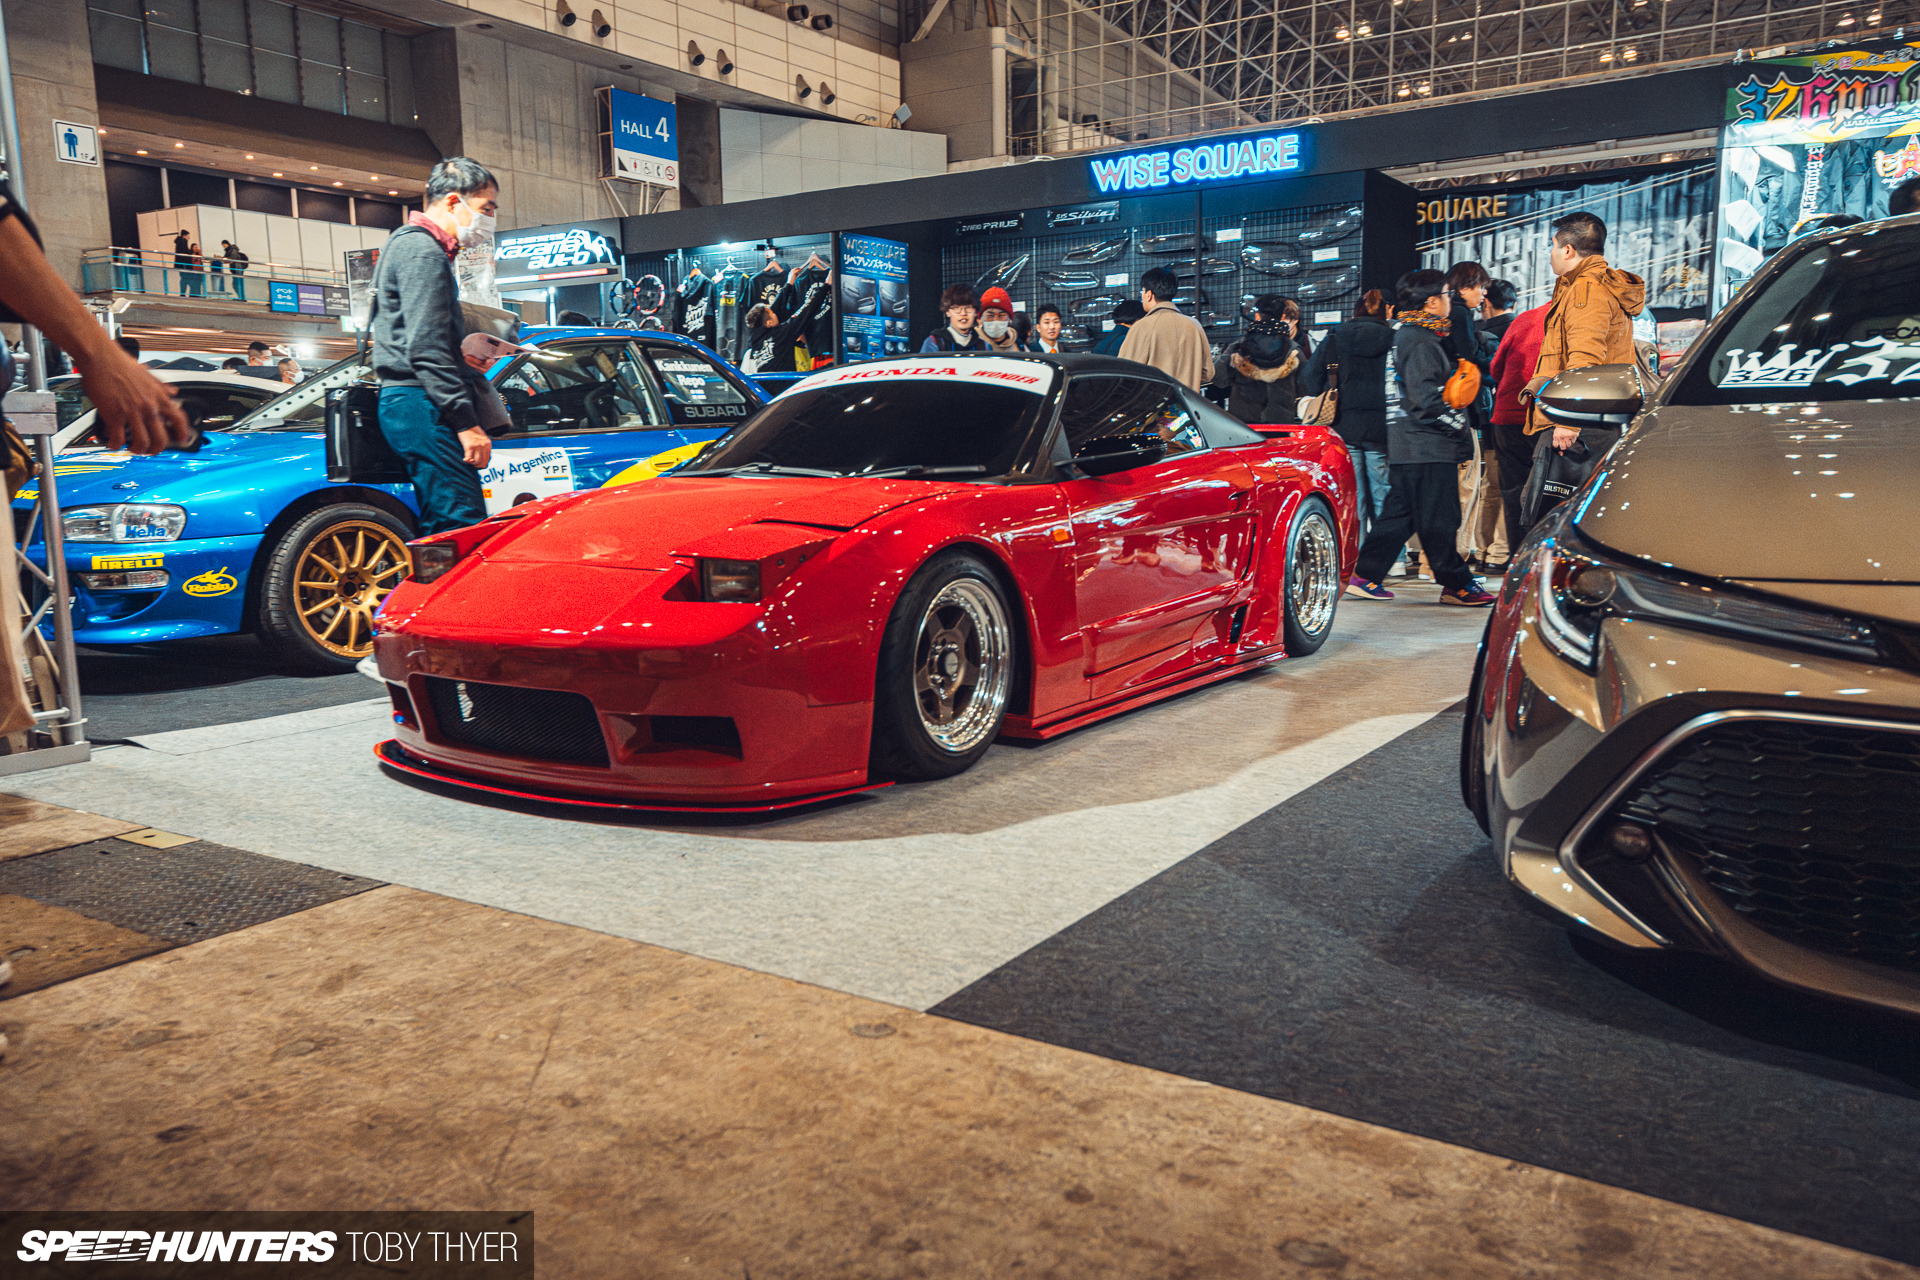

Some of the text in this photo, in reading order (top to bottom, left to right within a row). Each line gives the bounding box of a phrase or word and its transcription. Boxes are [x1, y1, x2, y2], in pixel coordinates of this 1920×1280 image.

[621, 116, 670, 143] HALL 4
[1091, 134, 1299, 192] WISE SQUARE
[1068, 208, 1113, 220] Silvia
[1416, 194, 1508, 225] SQUARE
[982, 219, 1019, 230] PRIUS
[843, 237, 906, 261] WISE SQUARE
[653, 360, 715, 372] Kankkunen
[676, 374, 706, 388] Repo
[835, 367, 1041, 385] HONDA WONDER
[684, 405, 747, 418] SUBARU
[508, 451, 564, 475] Argentina
[542, 465, 568, 475] YPF
[1543, 484, 1570, 496] BILSTEIN
[125, 524, 166, 538] Hella
[91, 552, 165, 570] PIRELLI
[188, 583, 231, 593] Robin
